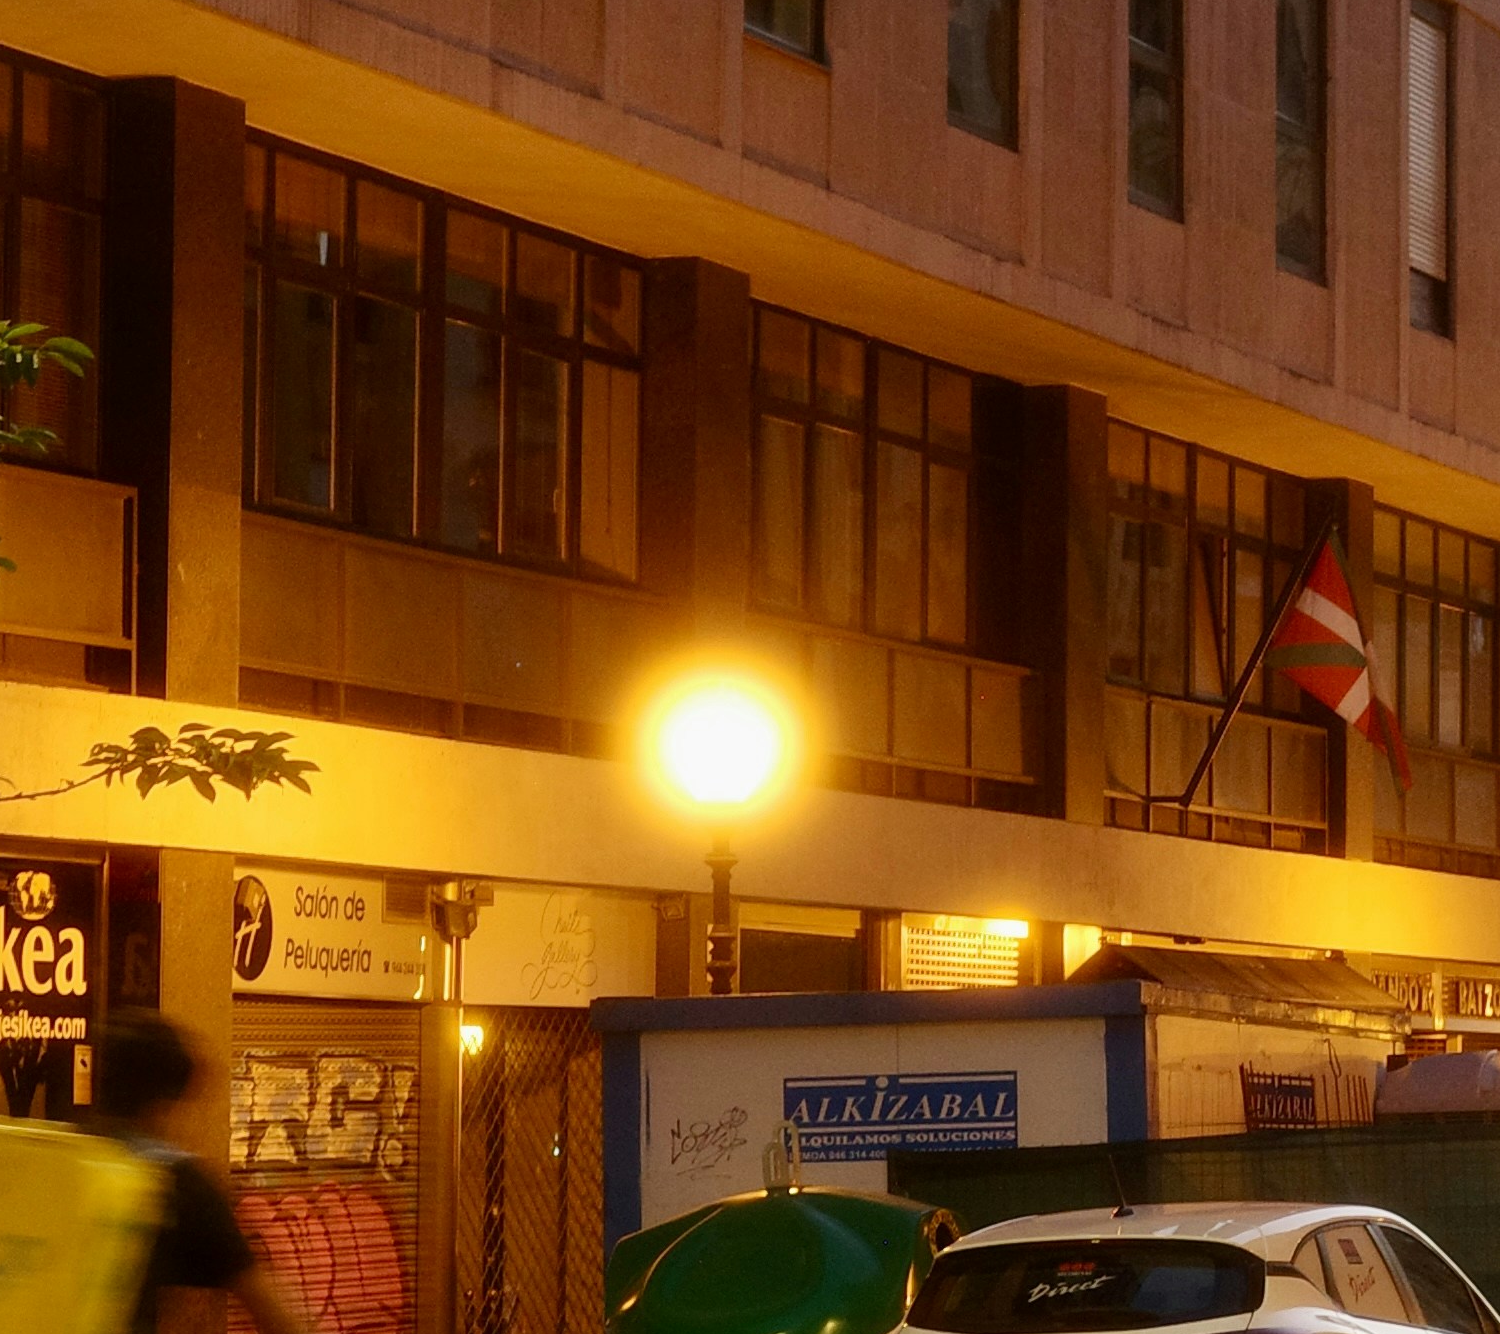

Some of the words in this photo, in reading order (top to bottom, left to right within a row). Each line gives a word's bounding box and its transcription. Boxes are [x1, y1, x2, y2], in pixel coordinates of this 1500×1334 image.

[294, 884, 339, 919] Salón
[343, 891, 366, 921] de
[284, 938, 372, 978] Peluquería
[905, 1129, 1016, 1143] SOLUCIONES
